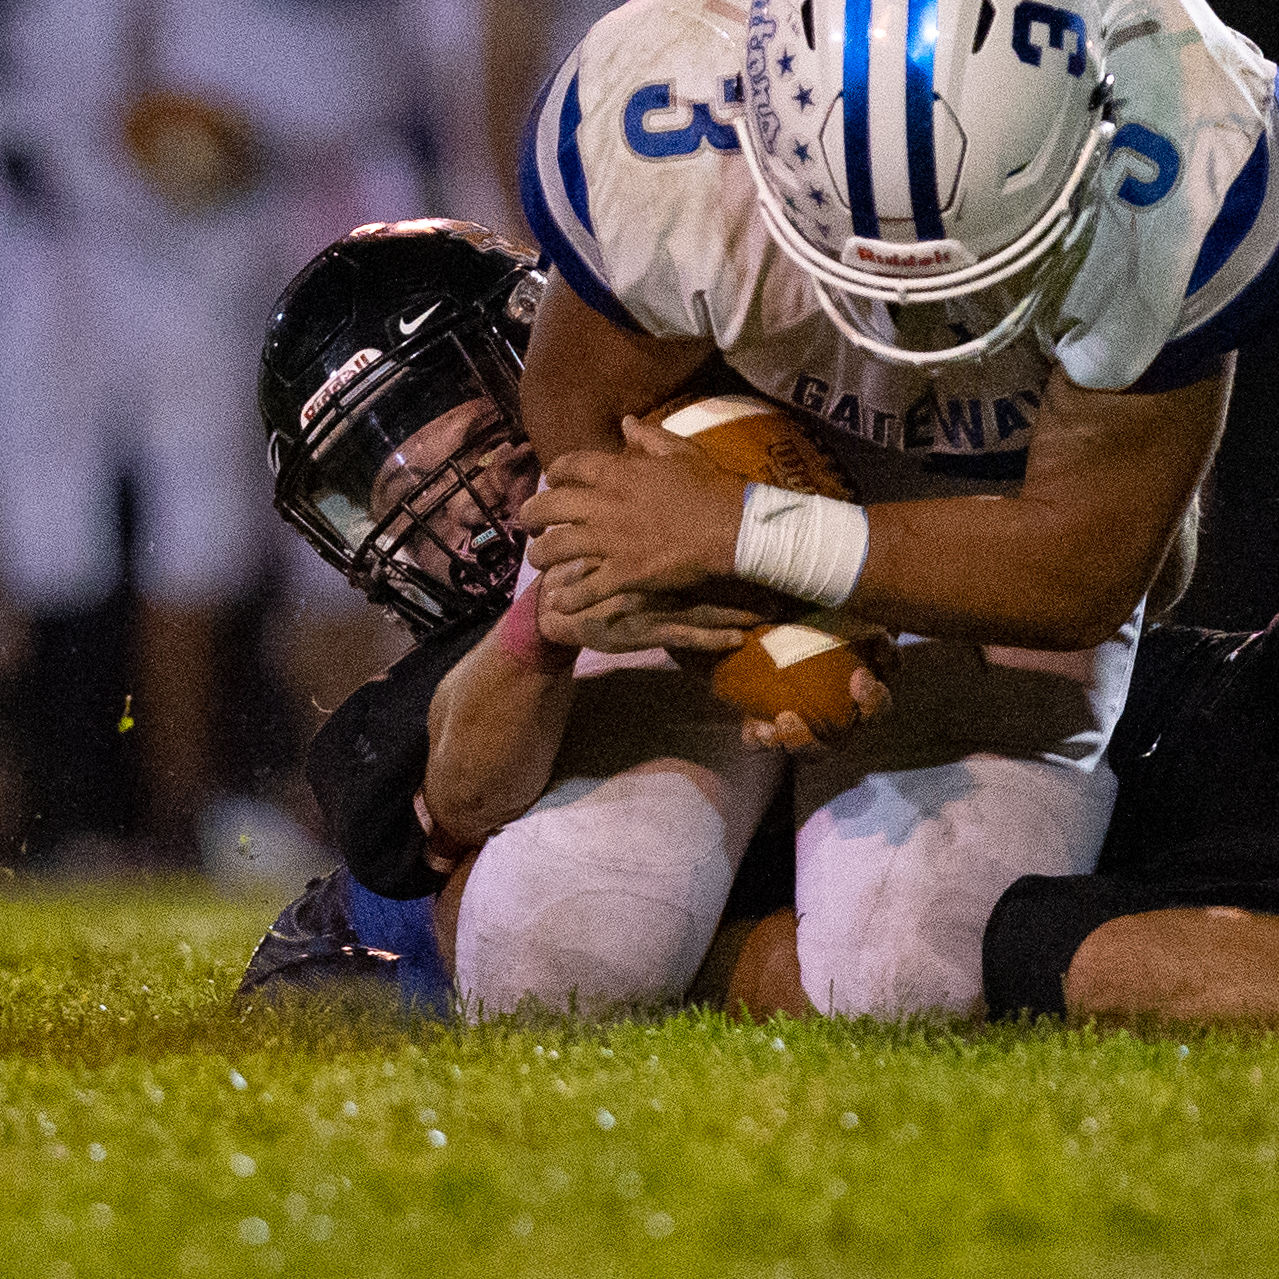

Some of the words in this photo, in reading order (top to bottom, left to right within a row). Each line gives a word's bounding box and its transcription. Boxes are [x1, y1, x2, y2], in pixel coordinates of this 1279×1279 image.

[1011, 0, 1087, 78] 3
[621, 72, 744, 161] 3
[790, 374, 1041, 450] GATEWA
